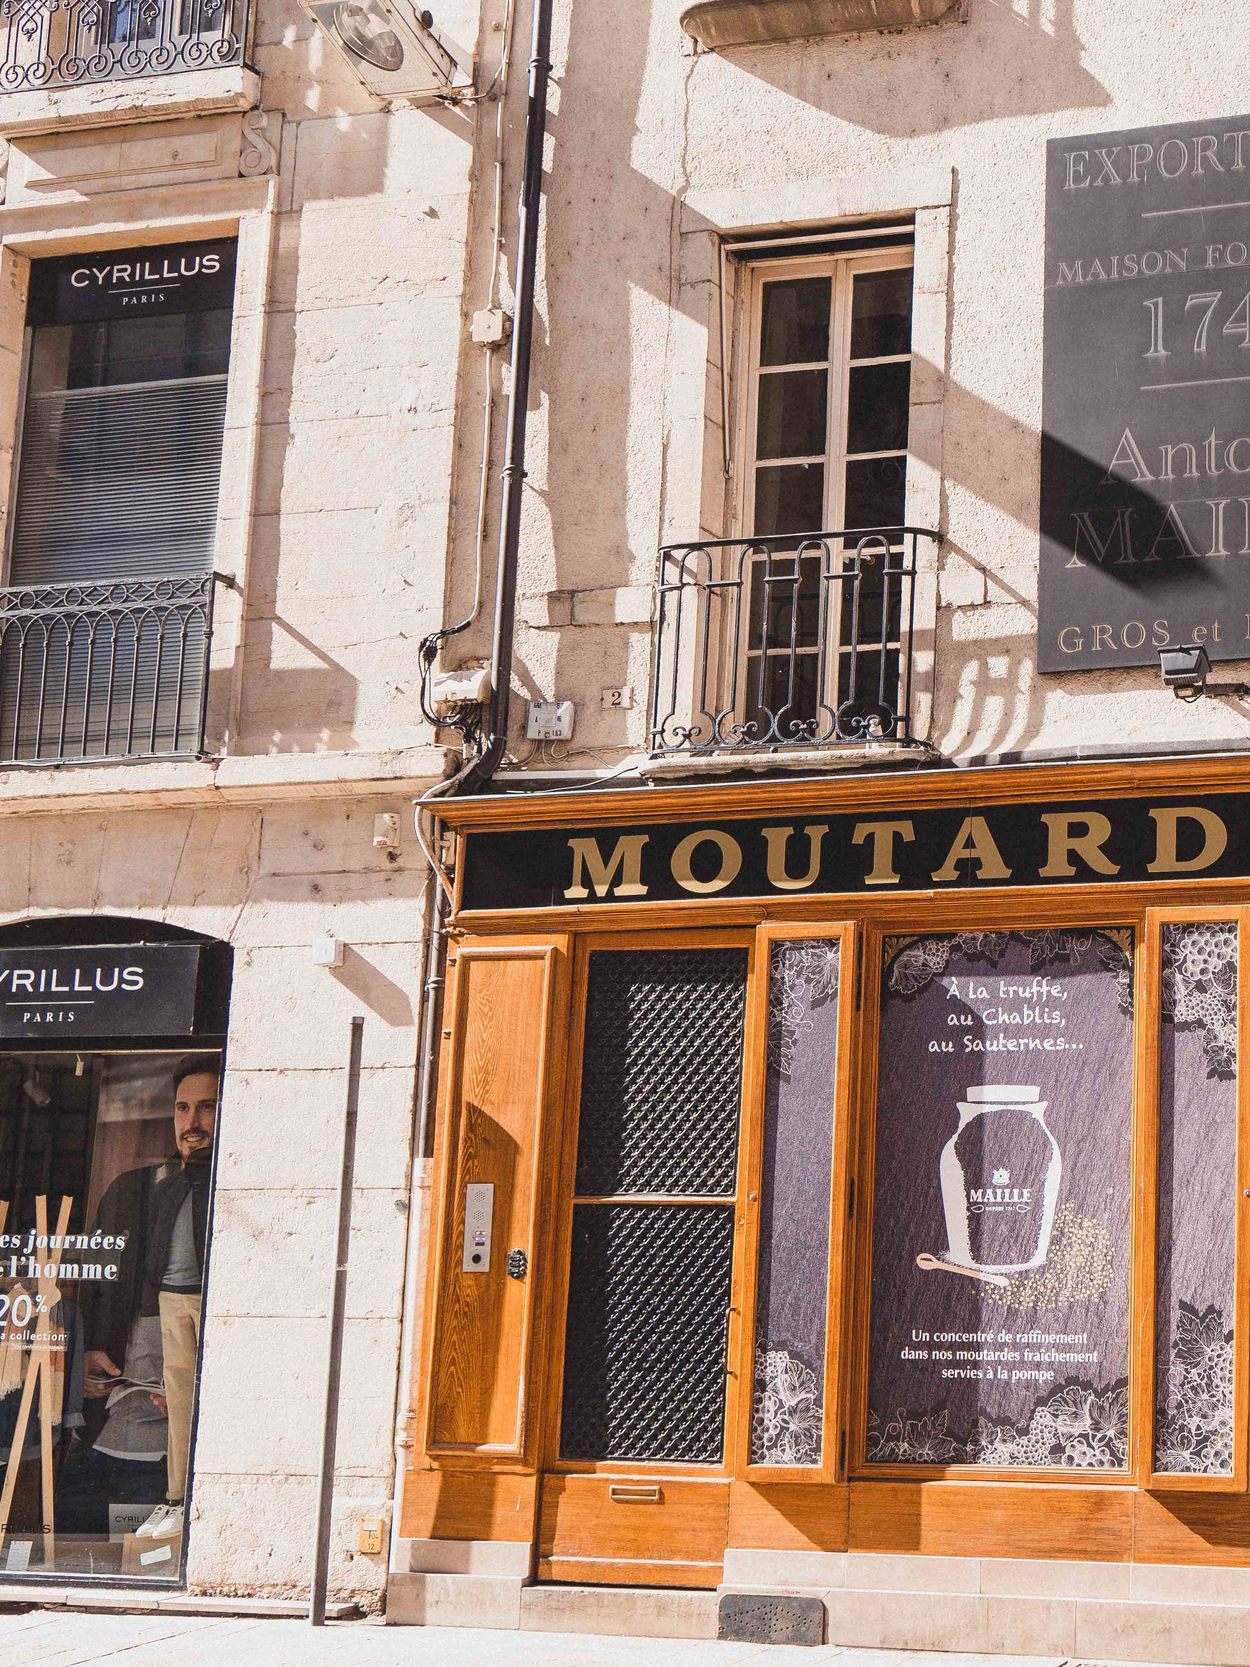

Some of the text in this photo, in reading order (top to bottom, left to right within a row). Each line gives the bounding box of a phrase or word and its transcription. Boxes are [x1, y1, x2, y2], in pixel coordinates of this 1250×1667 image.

[71, 254, 221, 288] CYRILLUS
[1056, 249, 1189, 283] MAISON
[122, 293, 165, 306] PARIS
[1057, 620, 1170, 653] GROS
[1191, 619, 1222, 644] et
[611, 691, 621, 706] 2
[946, 976, 1068, 1003] À la truffe,
[23, 1012, 75, 1022] PARIS
[947, 1004, 1066, 1028] au Chablis,
[928, 1033, 1084, 1053] au Sauternes...
[970, 1188, 1032, 1202] MAILLE
[23, 1229, 126, 1254] journées
[9, 1256, 118, 1280] l'homme
[912, 1330, 1088, 1344] Un concentré de raffinement
[901, 1347, 1098, 1362] dans nos moutardes fraîchement
[942, 1366, 1055, 1383] servies à la pompe
